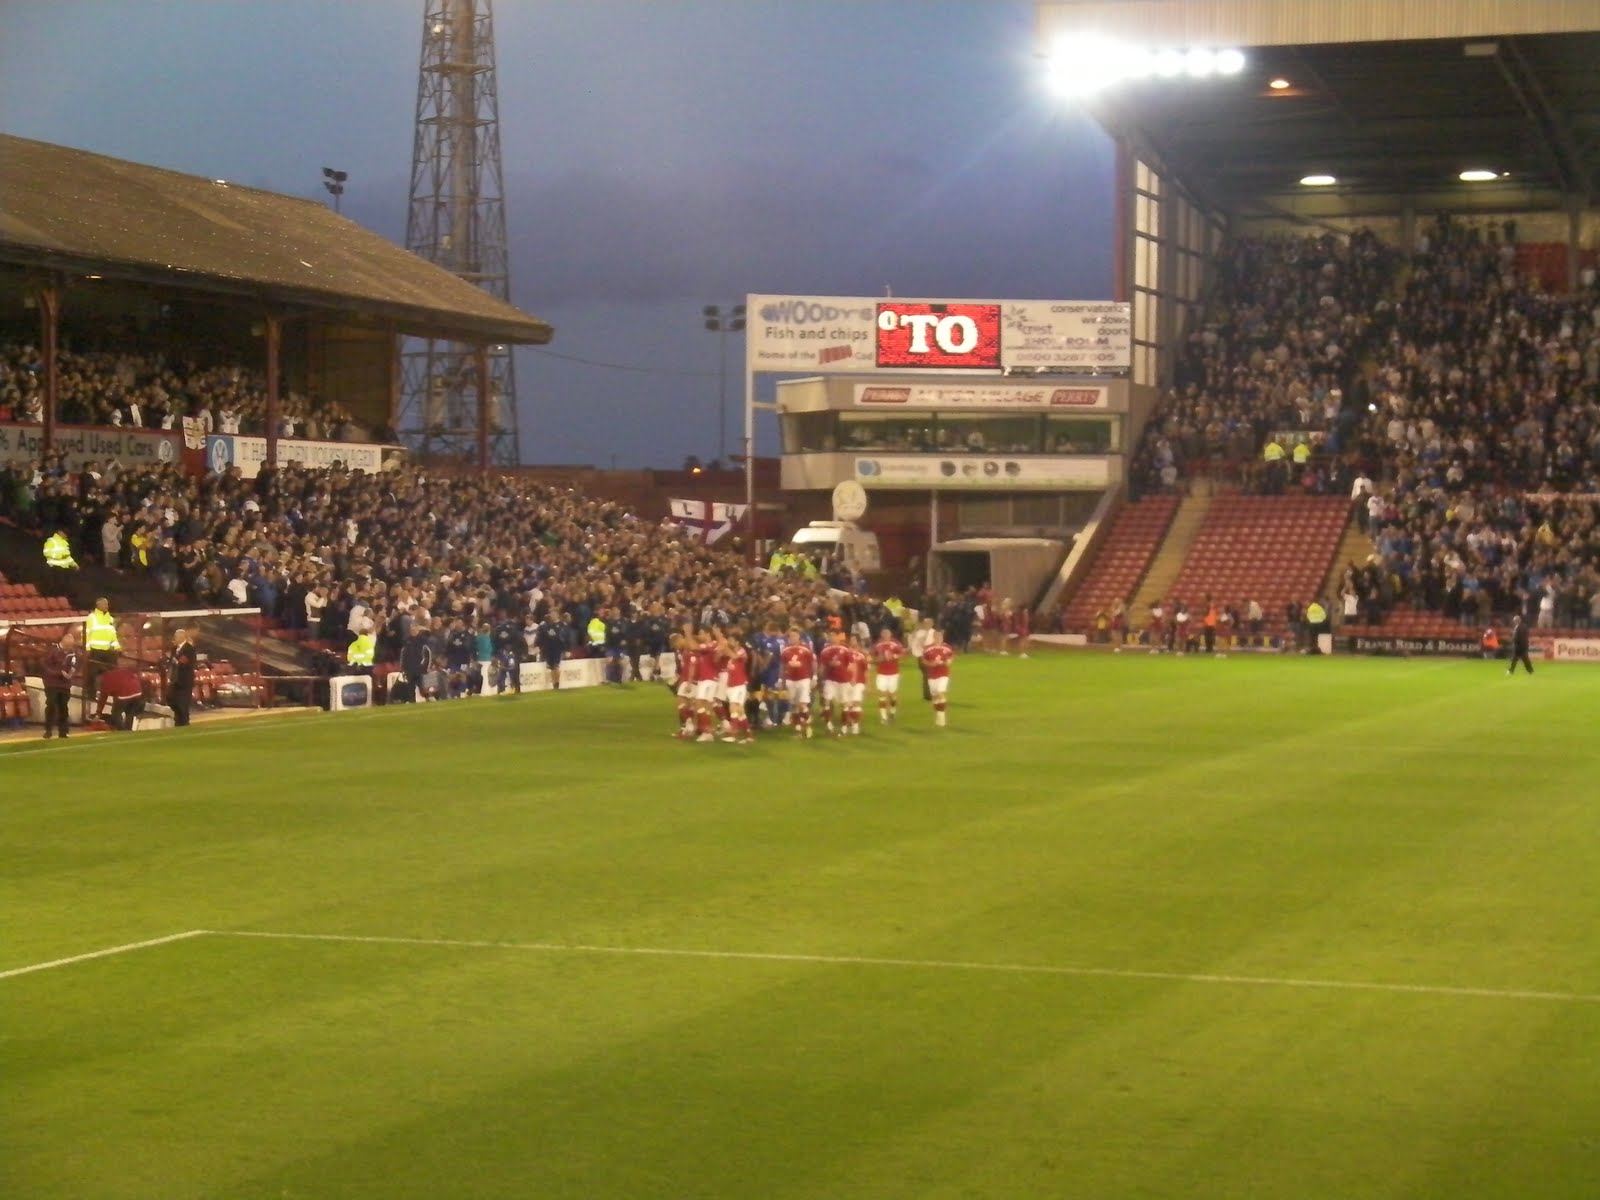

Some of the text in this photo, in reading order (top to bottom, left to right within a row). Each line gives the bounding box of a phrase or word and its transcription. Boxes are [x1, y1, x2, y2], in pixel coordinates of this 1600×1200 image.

[765, 327, 869, 342] Fish and chips
[758, 350, 785, 359] Home
[788, 350, 798, 359] of
[799, 350, 816, 359] the
[17, 429, 84, 458] Appoved
[91, 432, 121, 455] Used
[128, 435, 153, 457] Cars
